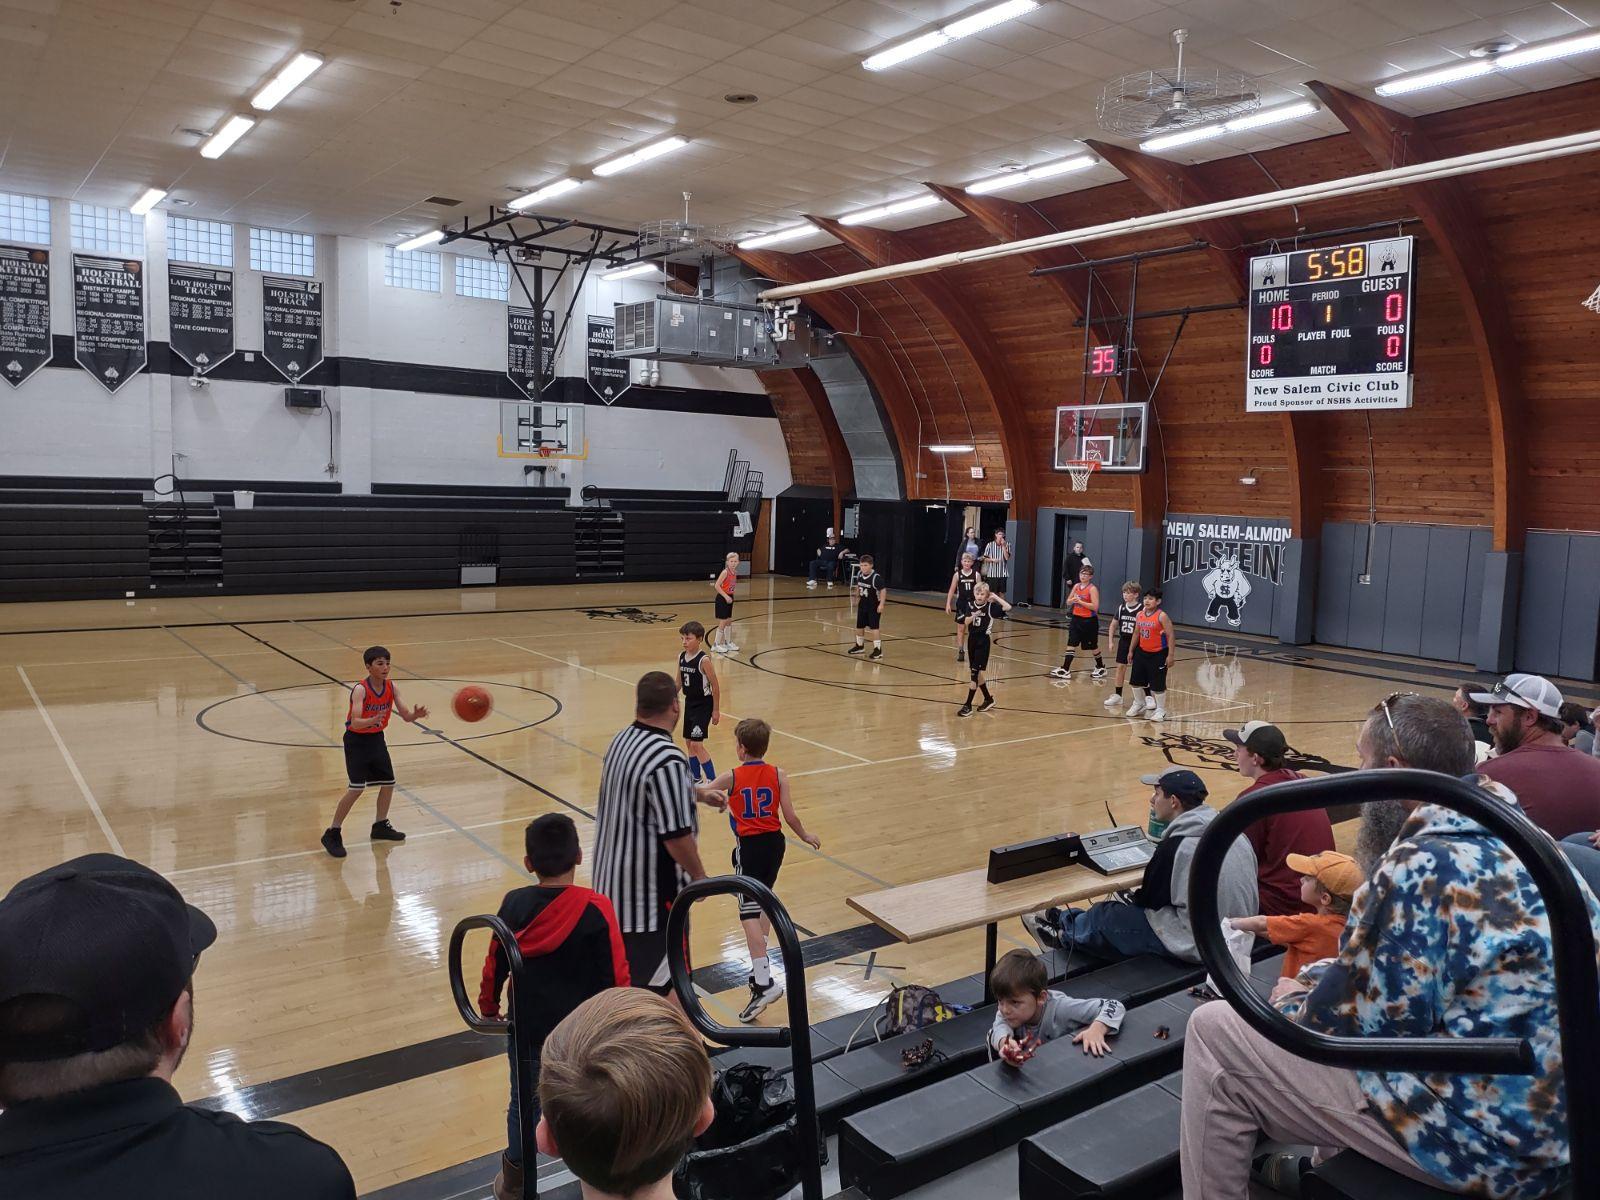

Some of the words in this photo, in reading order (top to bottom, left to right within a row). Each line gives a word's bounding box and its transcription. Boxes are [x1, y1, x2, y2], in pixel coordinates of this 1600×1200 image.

[2, 260, 48, 270] HOLSTEIN
[1308, 247, 1363, 279] 5:58
[82, 268, 135, 281] HOLSTEIN
[76, 274, 141, 288] BASKETBALL
[170, 278, 191, 287] LADY
[193, 281, 231, 291] HOLSTEIN
[1361, 276, 1402, 293] GUEST
[111, 287, 135, 295] CHAMPS
[185, 286, 217, 297] TRACK
[270, 289, 314, 301] HOLSTEIN
[1259, 289, 1290, 303] HOME
[1312, 290, 1340, 302] PERIOD
[171, 295, 197, 303] REGIONAL
[198, 298, 231, 306] COMPETITION
[279, 297, 307, 306] TRACK
[265, 305, 289, 313] REGIONAL
[290, 308, 321, 316] COMPETITION
[1327, 305, 1331, 323] 1
[1386, 294, 1402, 322] 0
[106, 312, 142, 320] COMPETITION
[1271, 304, 1292, 330] 10
[174, 323, 190, 331] STATE
[192, 325, 228, 334] COMPETITION
[1377, 324, 1404, 335] FOULS
[101, 336, 139, 344] COMPETITION
[1252, 335, 1275, 344] FOULS
[1298, 331, 1326, 342] PLAYER
[1331, 329, 1351, 339] FOUL
[1387, 335, 1400, 357] 0
[1260, 345, 1272, 365] 0
[1092, 349, 1114, 374] 35
[1376, 362, 1403, 372] SCORE
[1251, 369, 1275, 378] SCORE
[1310, 366, 1337, 375] MATCH
[1254, 386, 1278, 395] New
[1283, 384, 1321, 395] Salem
[1327, 382, 1361, 393] Civic
[1367, 381, 1399, 392] Club
[1280, 399, 1313, 408] Sponsor
[1354, 396, 1398, 404] Activities
[1167, 521, 1194, 537] NEW
[965, 582, 971, 591] 11
[1121, 621, 1135, 634] 25
[684, 672, 690, 686] 3
[740, 787, 773, 819] 12
